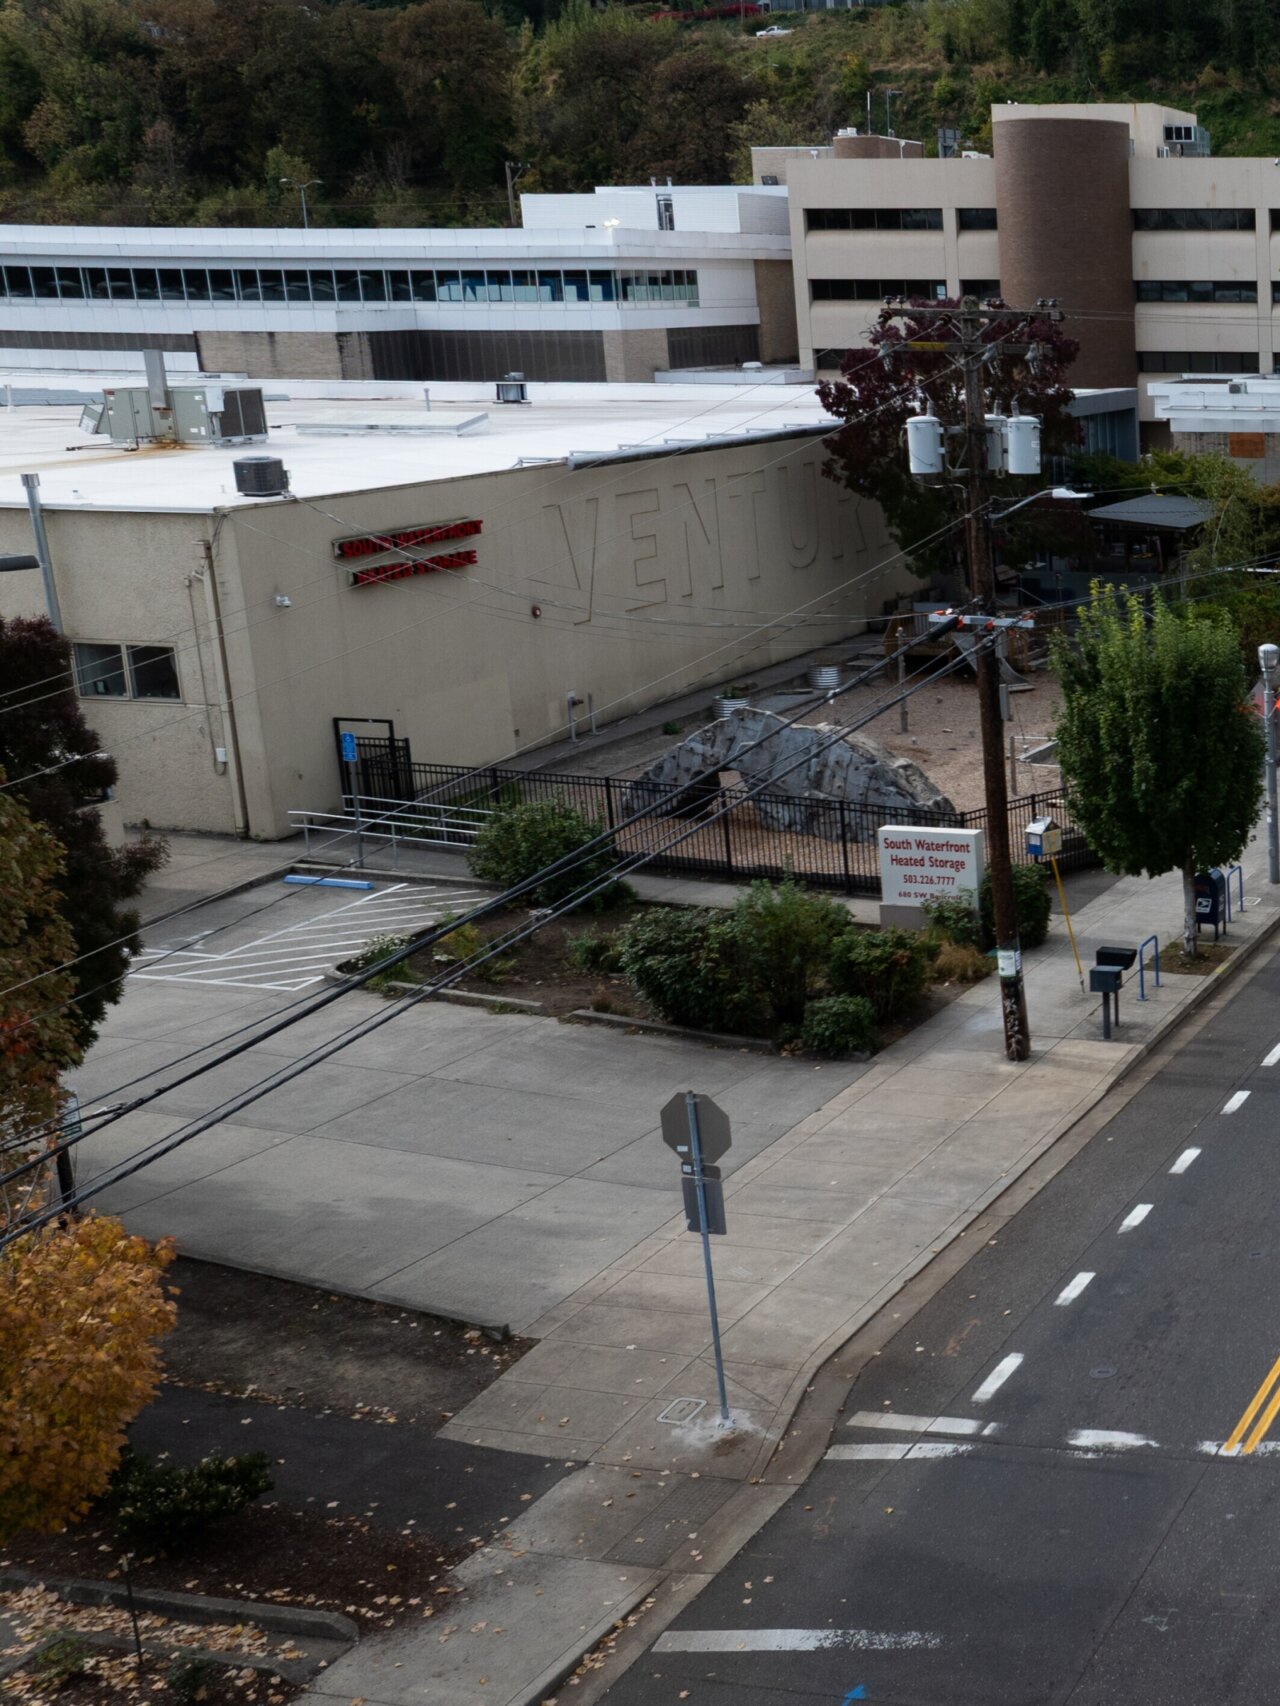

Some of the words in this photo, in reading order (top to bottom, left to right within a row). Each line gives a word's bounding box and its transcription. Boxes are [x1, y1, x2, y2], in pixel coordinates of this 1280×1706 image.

[542, 462, 894, 626] VENTUR
[883, 837, 912, 851] South
[915, 839, 971, 854] Waterfront
[890, 854, 925, 868] Heated
[928, 856, 966, 873] Storage
[903, 874, 955, 886] 503.226.7777
[913, 891, 927, 899] SW
